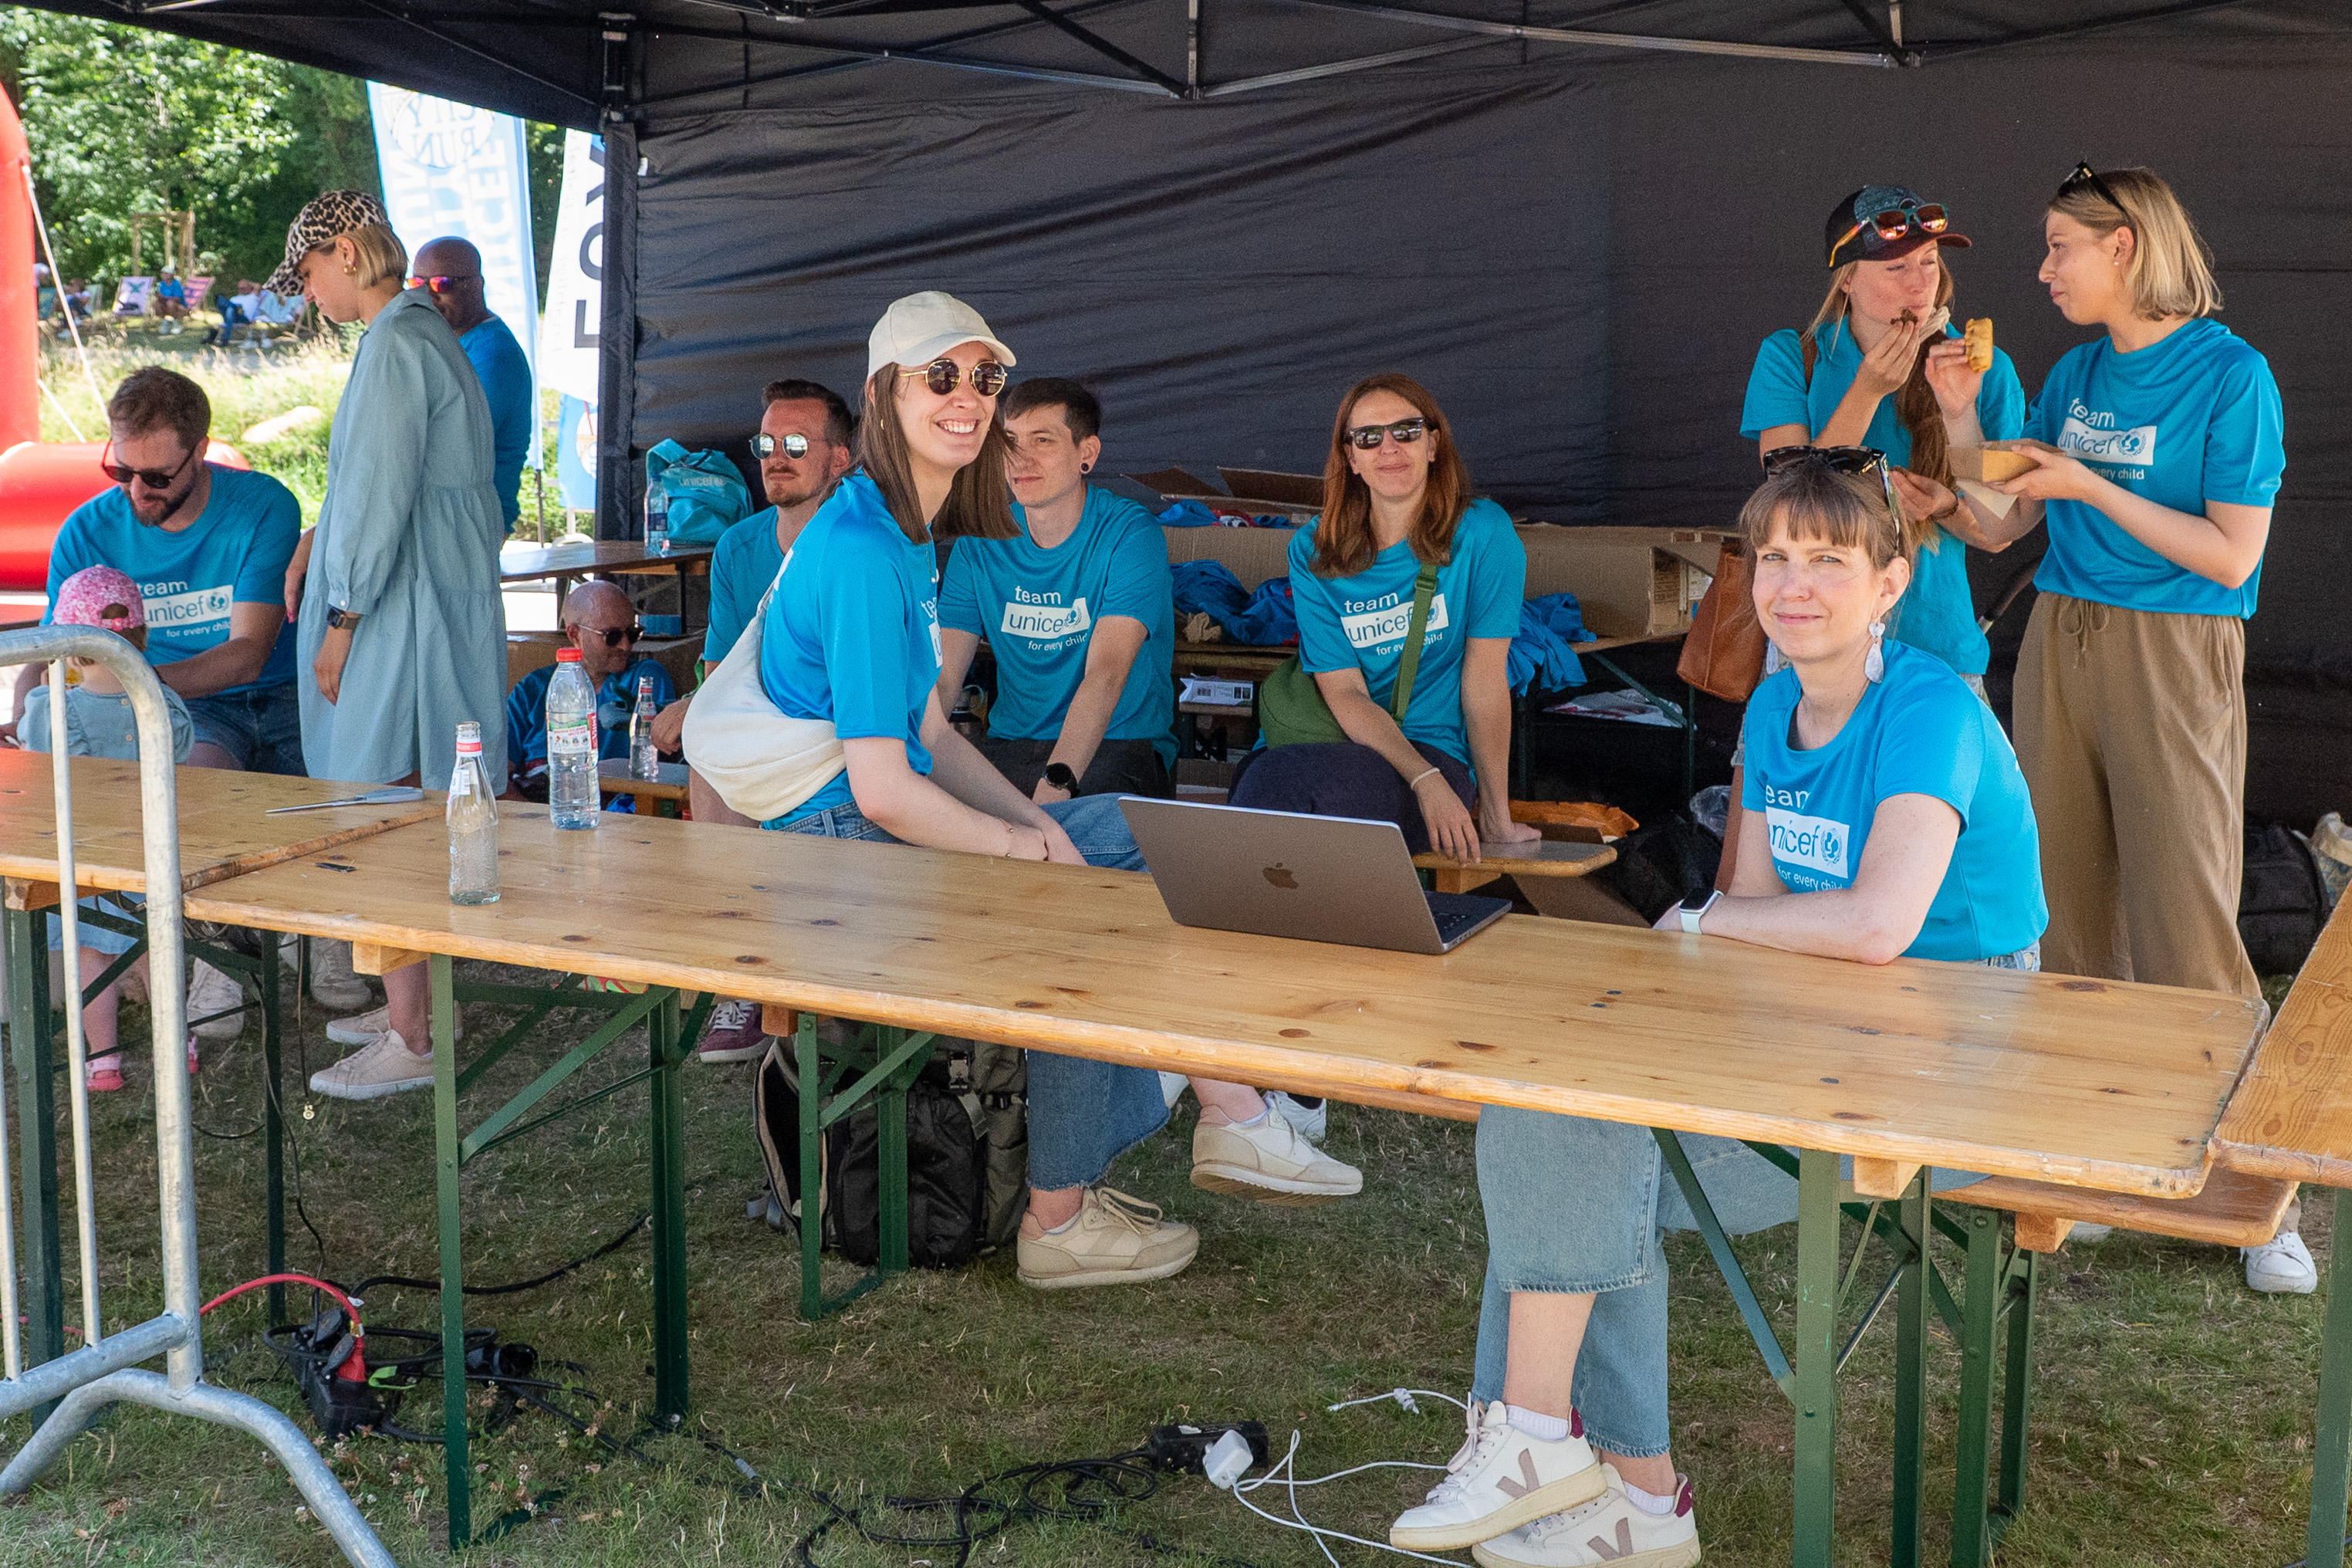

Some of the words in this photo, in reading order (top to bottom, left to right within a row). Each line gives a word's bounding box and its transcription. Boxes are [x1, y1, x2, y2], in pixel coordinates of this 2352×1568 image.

[2068, 397, 2115, 428] team
[2060, 431, 2122, 455] unicef
[2117, 467, 2144, 480] child
[137, 580, 188, 597] team
[1015, 586, 1061, 605] team
[144, 595, 204, 623] unicef
[1344, 592, 1399, 613] team
[166, 629, 181, 637] for
[183, 626, 211, 636] every
[1009, 612, 1063, 633] unice
[1347, 606, 1414, 642] unicef
[1028, 640, 1043, 651] for
[1376, 646, 1391, 656] for
[1765, 784, 1811, 809] ea
[1772, 819, 1820, 857] nicef
[1776, 865, 1791, 880] for
[1793, 873, 1819, 892] every
